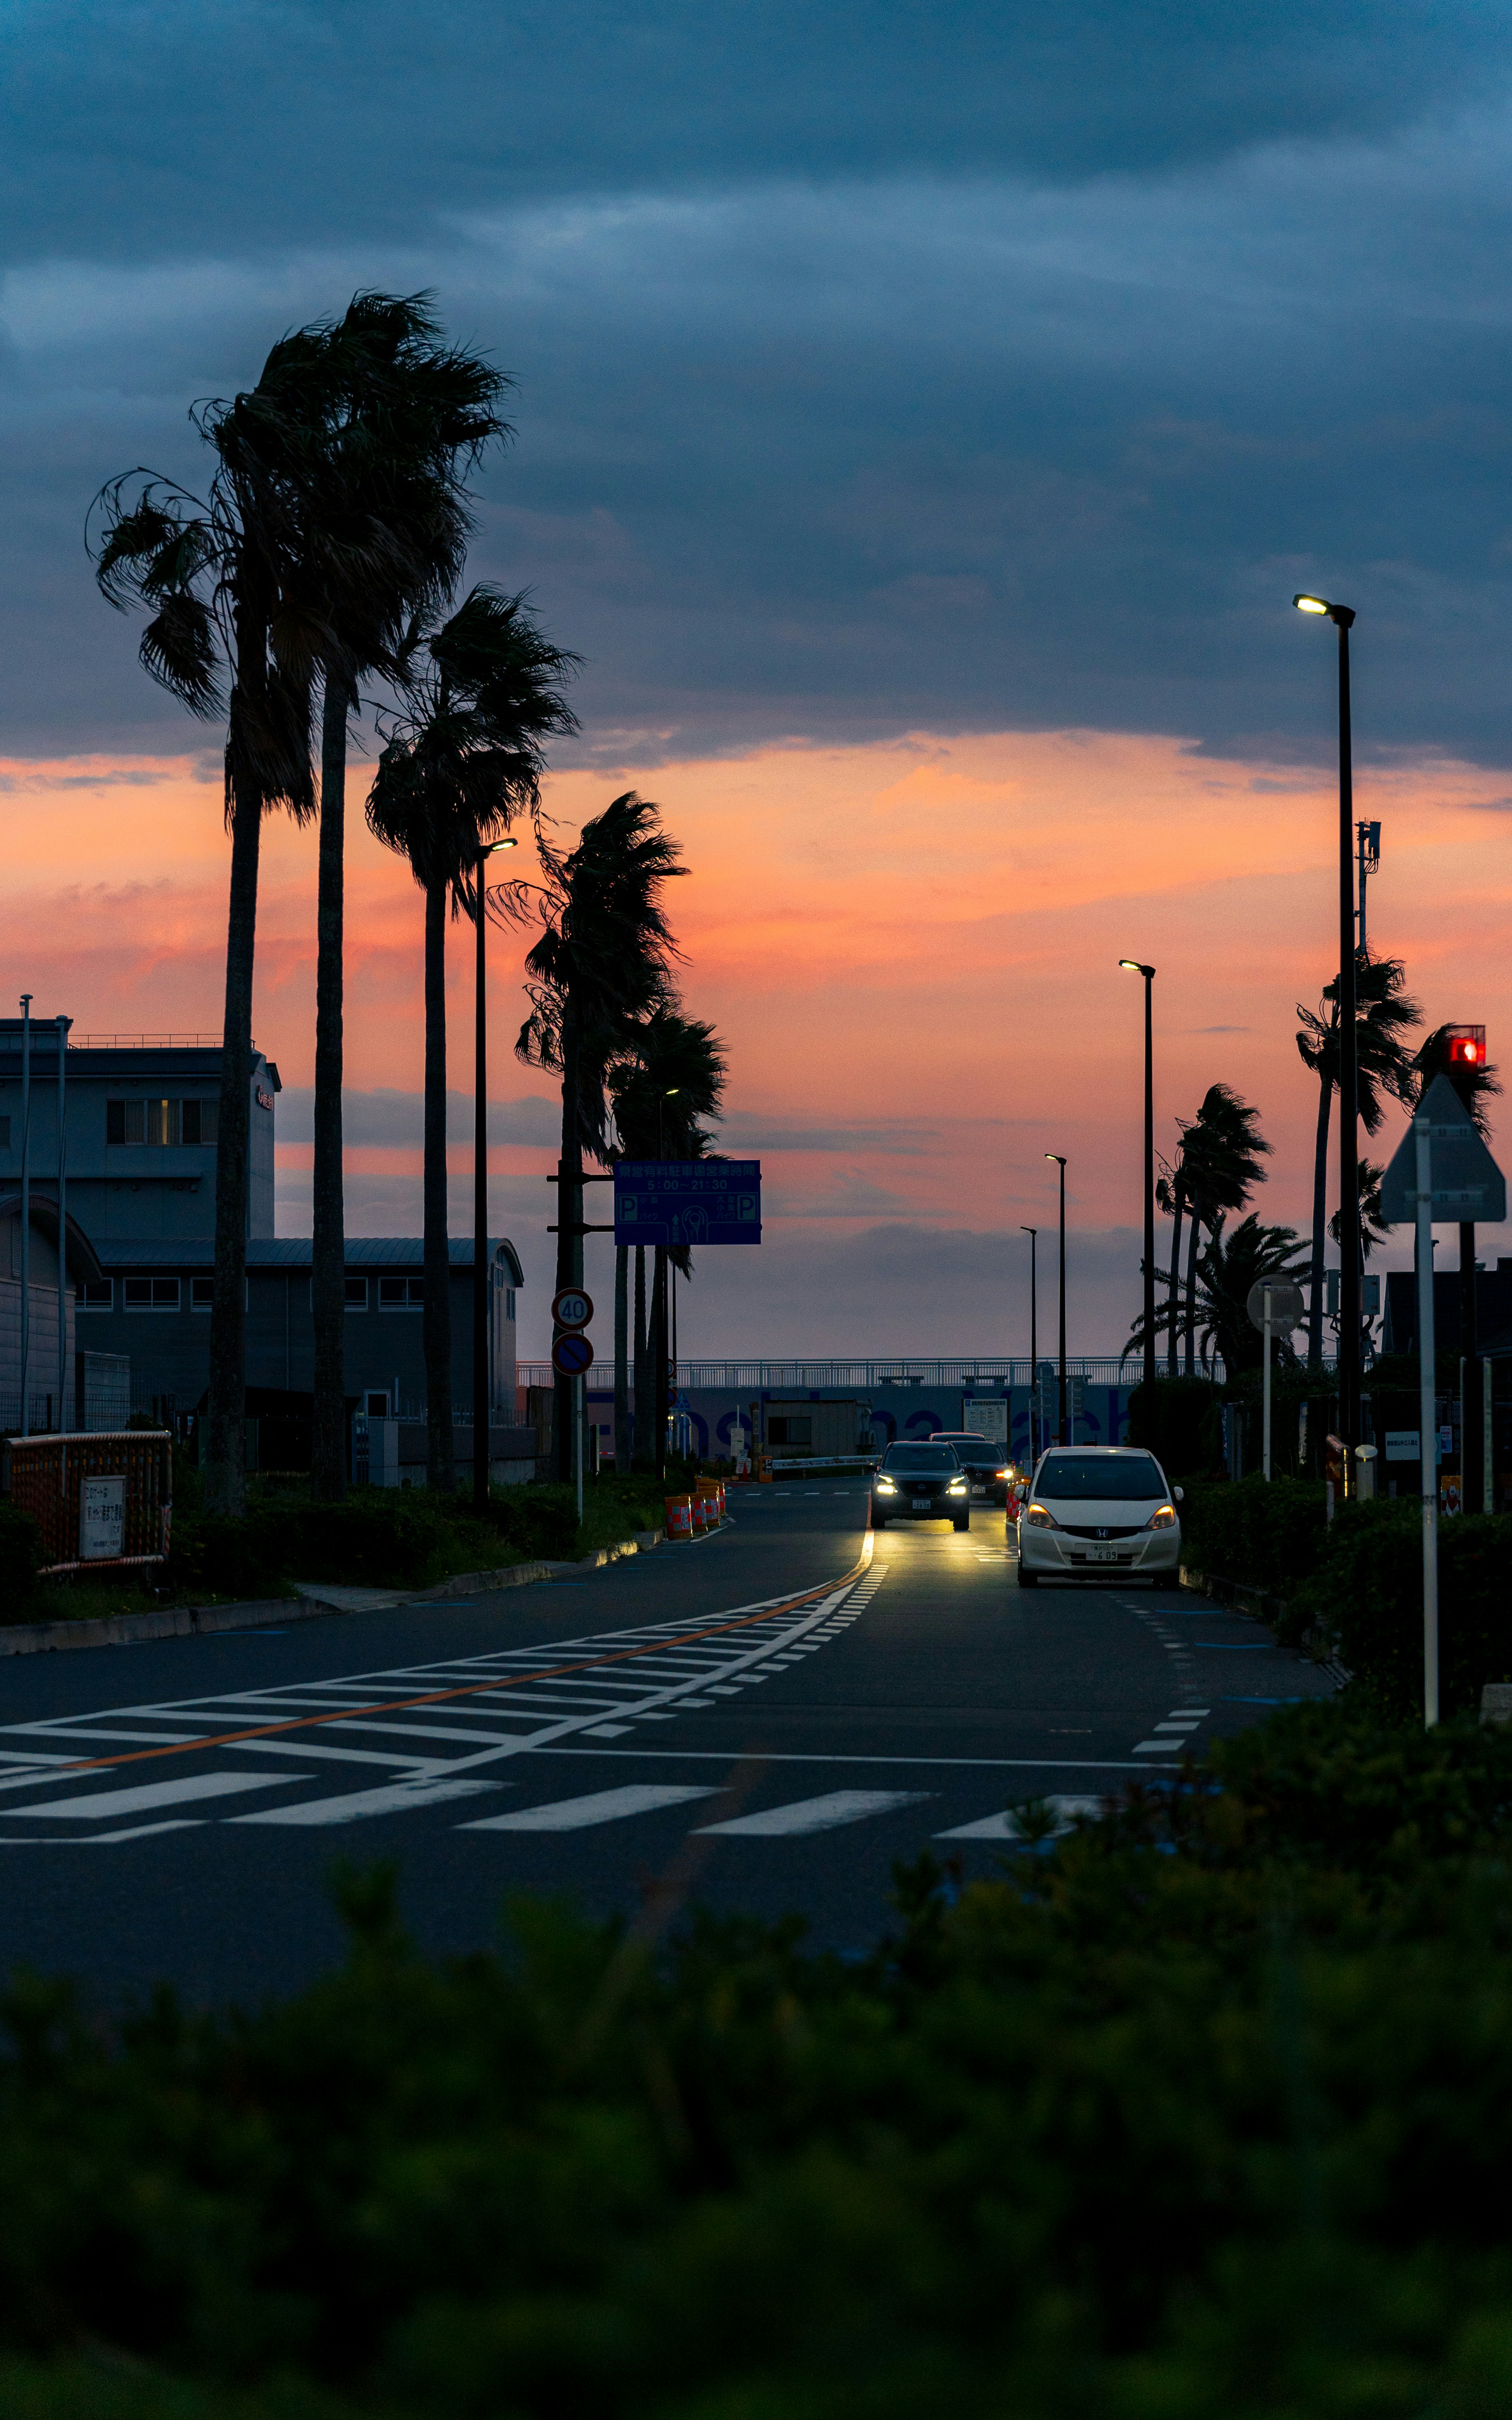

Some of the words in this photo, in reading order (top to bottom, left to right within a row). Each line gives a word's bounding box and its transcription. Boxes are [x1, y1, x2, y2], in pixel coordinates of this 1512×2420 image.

[619, 1164, 755, 1177] 県営有料駐車場営業時間
[622, 1197, 635, 1220] P
[740, 1196, 754, 1218] P
[561, 1300, 584, 1319] 40
